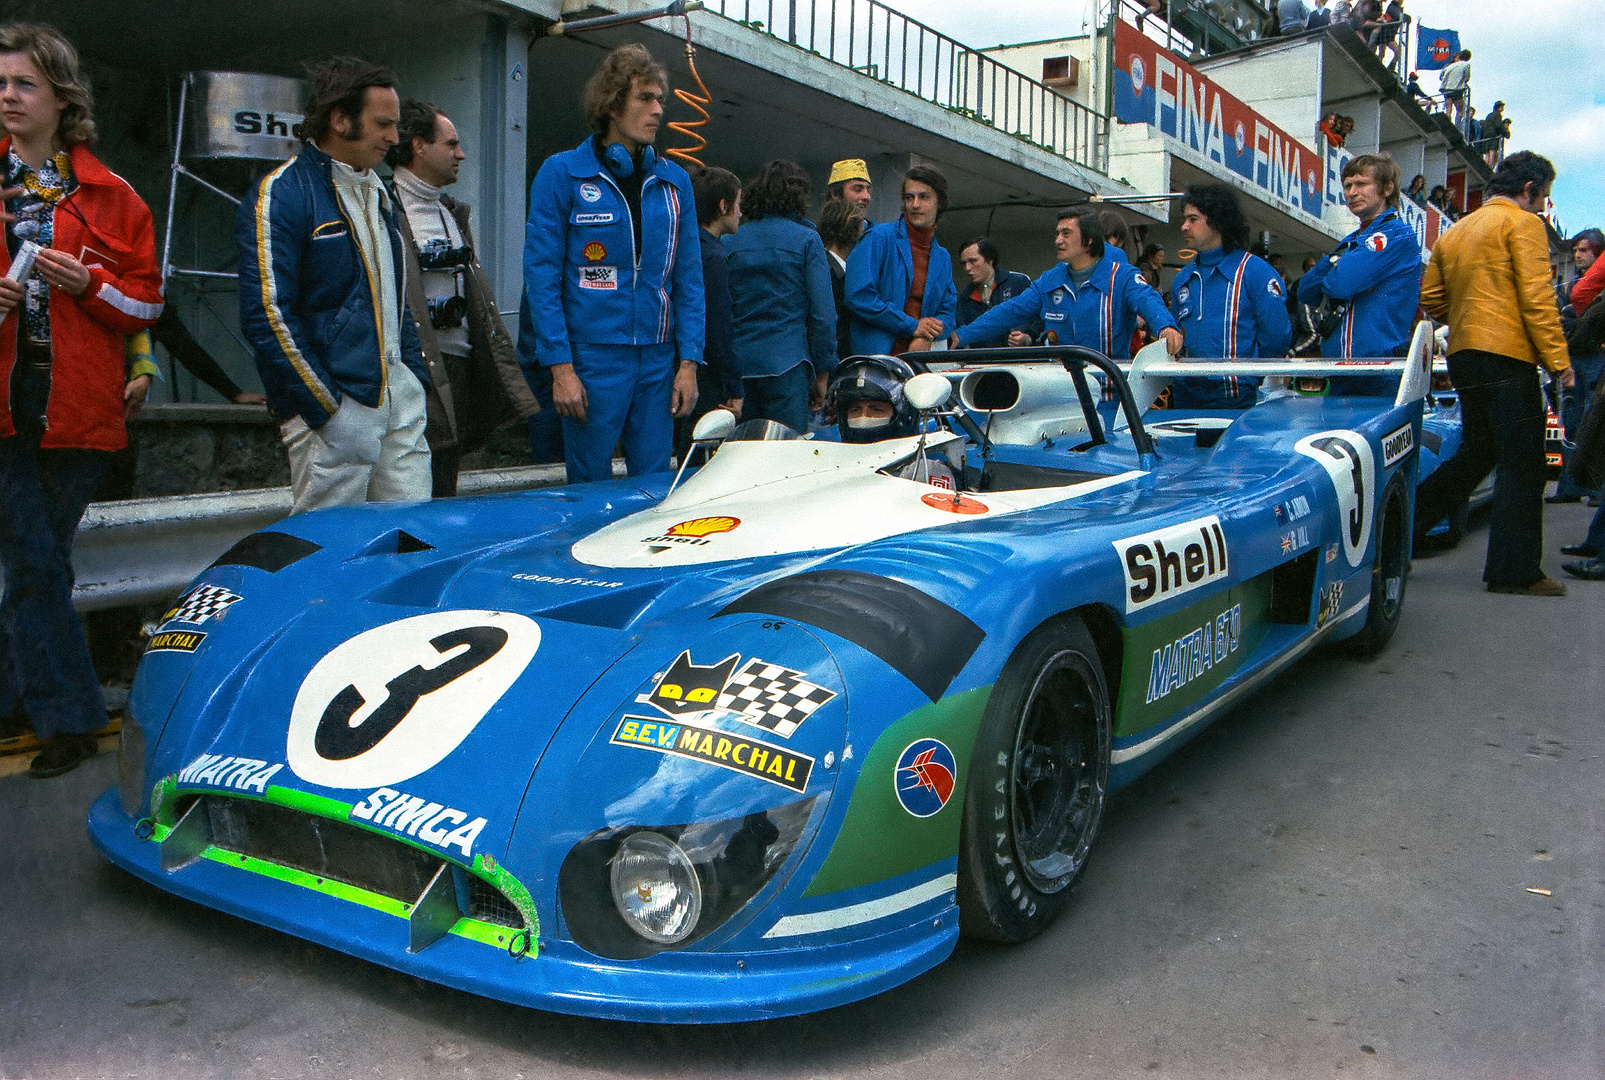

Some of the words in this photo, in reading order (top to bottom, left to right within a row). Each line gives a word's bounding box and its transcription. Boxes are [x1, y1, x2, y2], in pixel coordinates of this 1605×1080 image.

[1154, 52, 1226, 168] FINA
[1252, 119, 1302, 210] FINA
[1309, 436, 1364, 549] 3
[511, 573, 624, 588] GOODYEAR
[1125, 523, 1226, 604] Shell
[314, 625, 509, 761] 3
[1146, 620, 1213, 705] MATRA
[1215, 603, 1241, 664] 670
[177, 752, 285, 794] MATRA
[678, 728, 796, 783] MARCHAL
[351, 787, 488, 857] SIMCA
